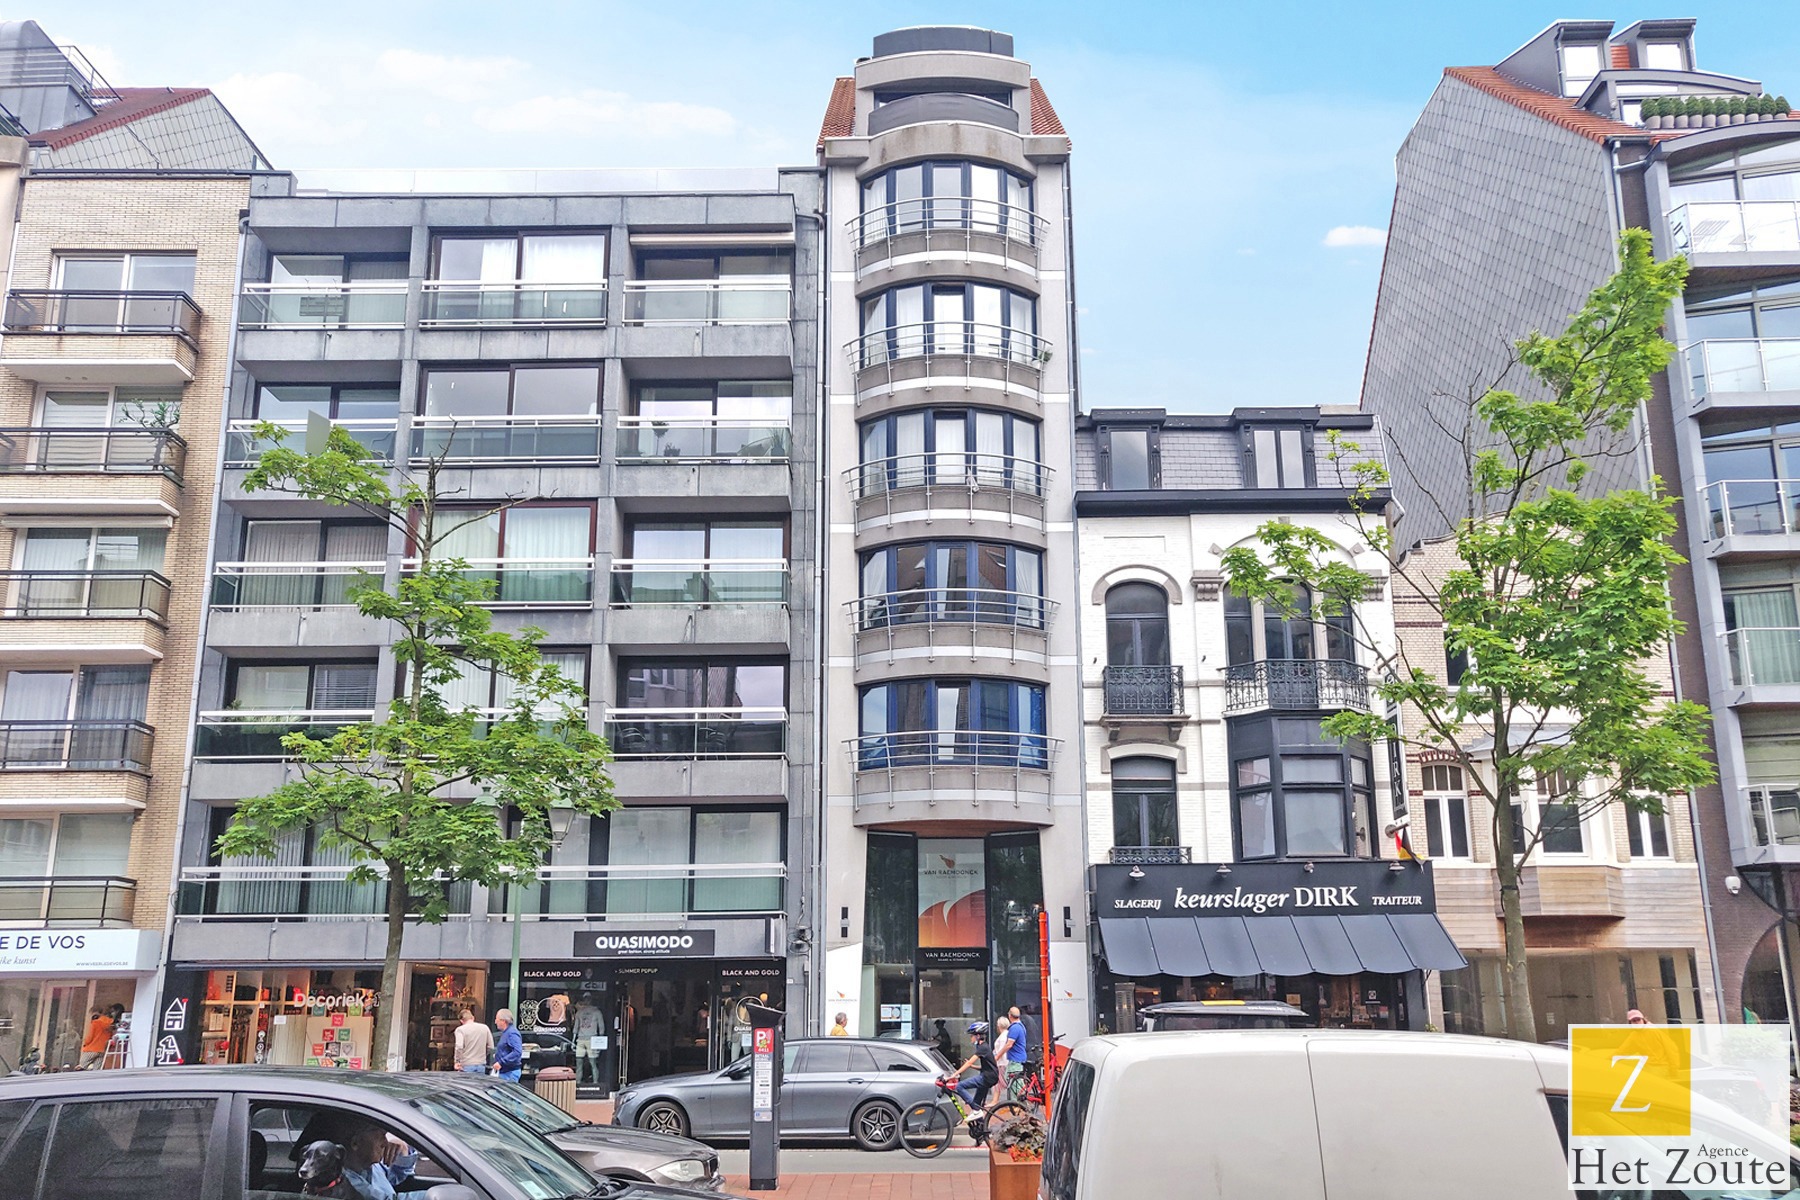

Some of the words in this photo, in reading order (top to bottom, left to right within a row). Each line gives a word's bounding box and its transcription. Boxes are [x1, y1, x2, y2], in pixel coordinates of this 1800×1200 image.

[1114, 899, 1162, 911] SLAGERIJ
[1174, 886, 1290, 914] keurslager
[1293, 886, 1359, 907] DIRK
[1371, 895, 1423, 906] TRAITEUR
[16, 936, 41, 950] DE
[48, 935, 86, 949] VOS
[595, 935, 694, 950] QUASIMODO
[14, 956, 36, 964] kunst
[294, 992, 365, 1008] Decoriek
[756, 1030, 766, 1046] P
